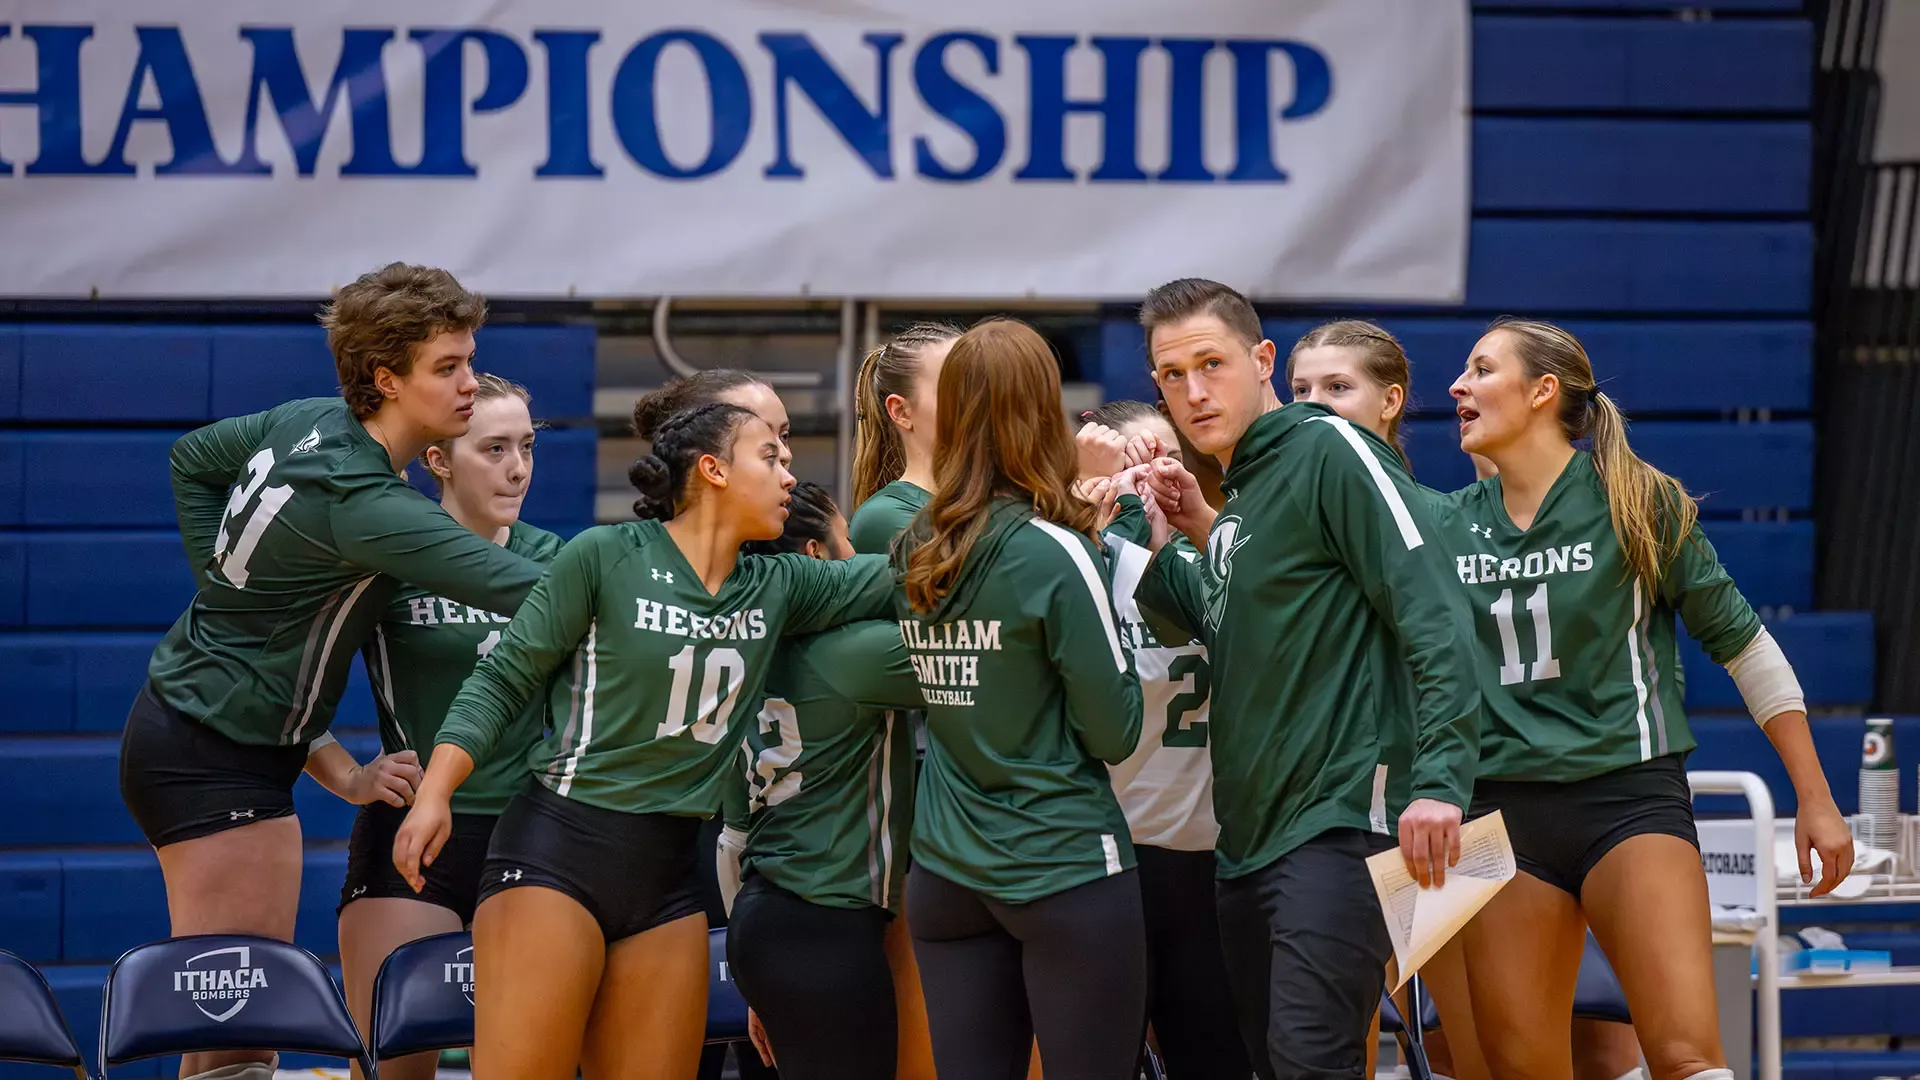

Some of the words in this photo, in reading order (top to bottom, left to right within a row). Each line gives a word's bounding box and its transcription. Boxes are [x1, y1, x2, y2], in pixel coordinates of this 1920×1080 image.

[0, 23, 1334, 185] HAMPIONSHIP
[213, 447, 295, 590] 21
[1456, 541, 1594, 584] HERONS
[634, 597, 767, 640] HERONS
[1490, 582, 1561, 686] 11
[655, 644, 745, 745] 10
[910, 654, 980, 687] SMITH
[741, 697, 803, 814] 2
[174, 967, 269, 991] ITHACA
[192, 989, 250, 1001] BOMBERS
